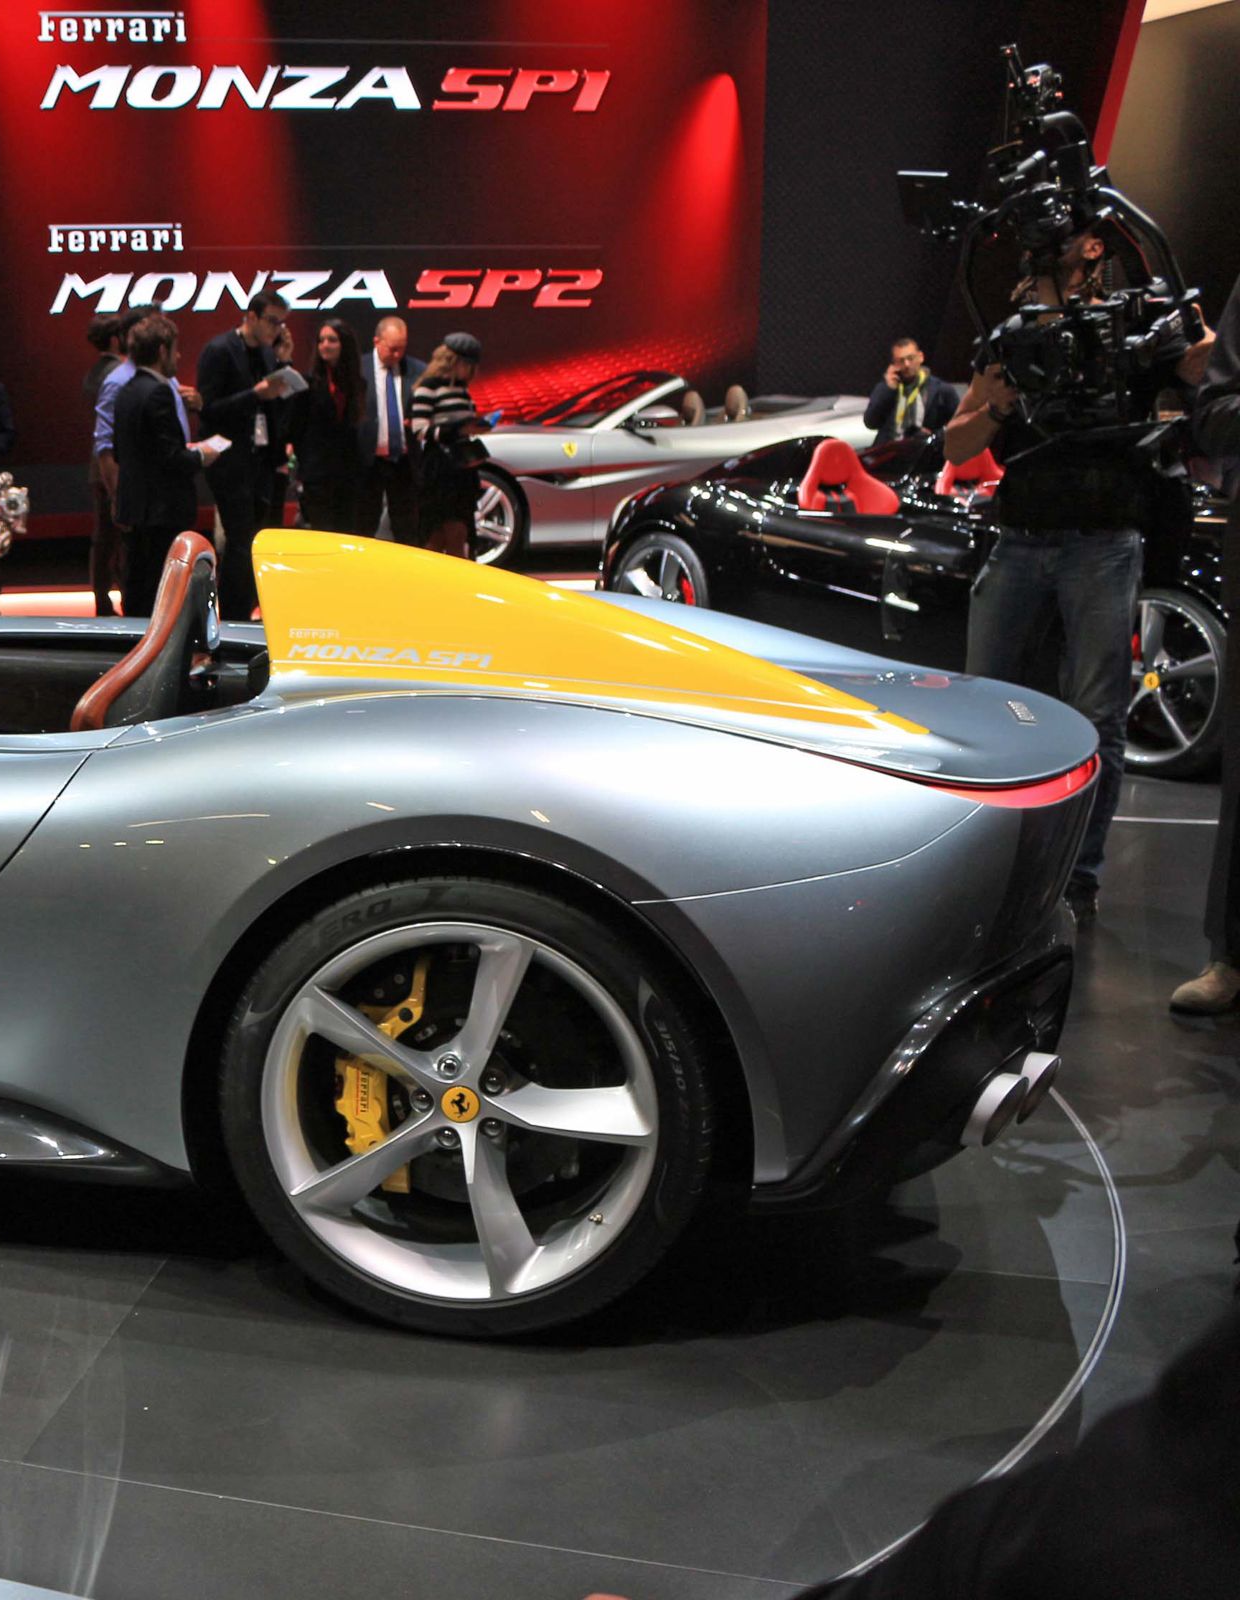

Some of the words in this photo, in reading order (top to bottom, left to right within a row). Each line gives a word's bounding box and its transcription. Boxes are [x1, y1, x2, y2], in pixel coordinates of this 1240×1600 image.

[38, 11, 187, 42] Ferrari
[40, 64, 421, 110] MONZA
[432, 67, 610, 112] SP1
[48, 223, 184, 253] Ferrari
[49, 270, 398, 314] MONZA
[408, 269, 603, 308] SP2
[288, 628, 340, 640] Ferrari
[287, 644, 421, 664] MONZA
